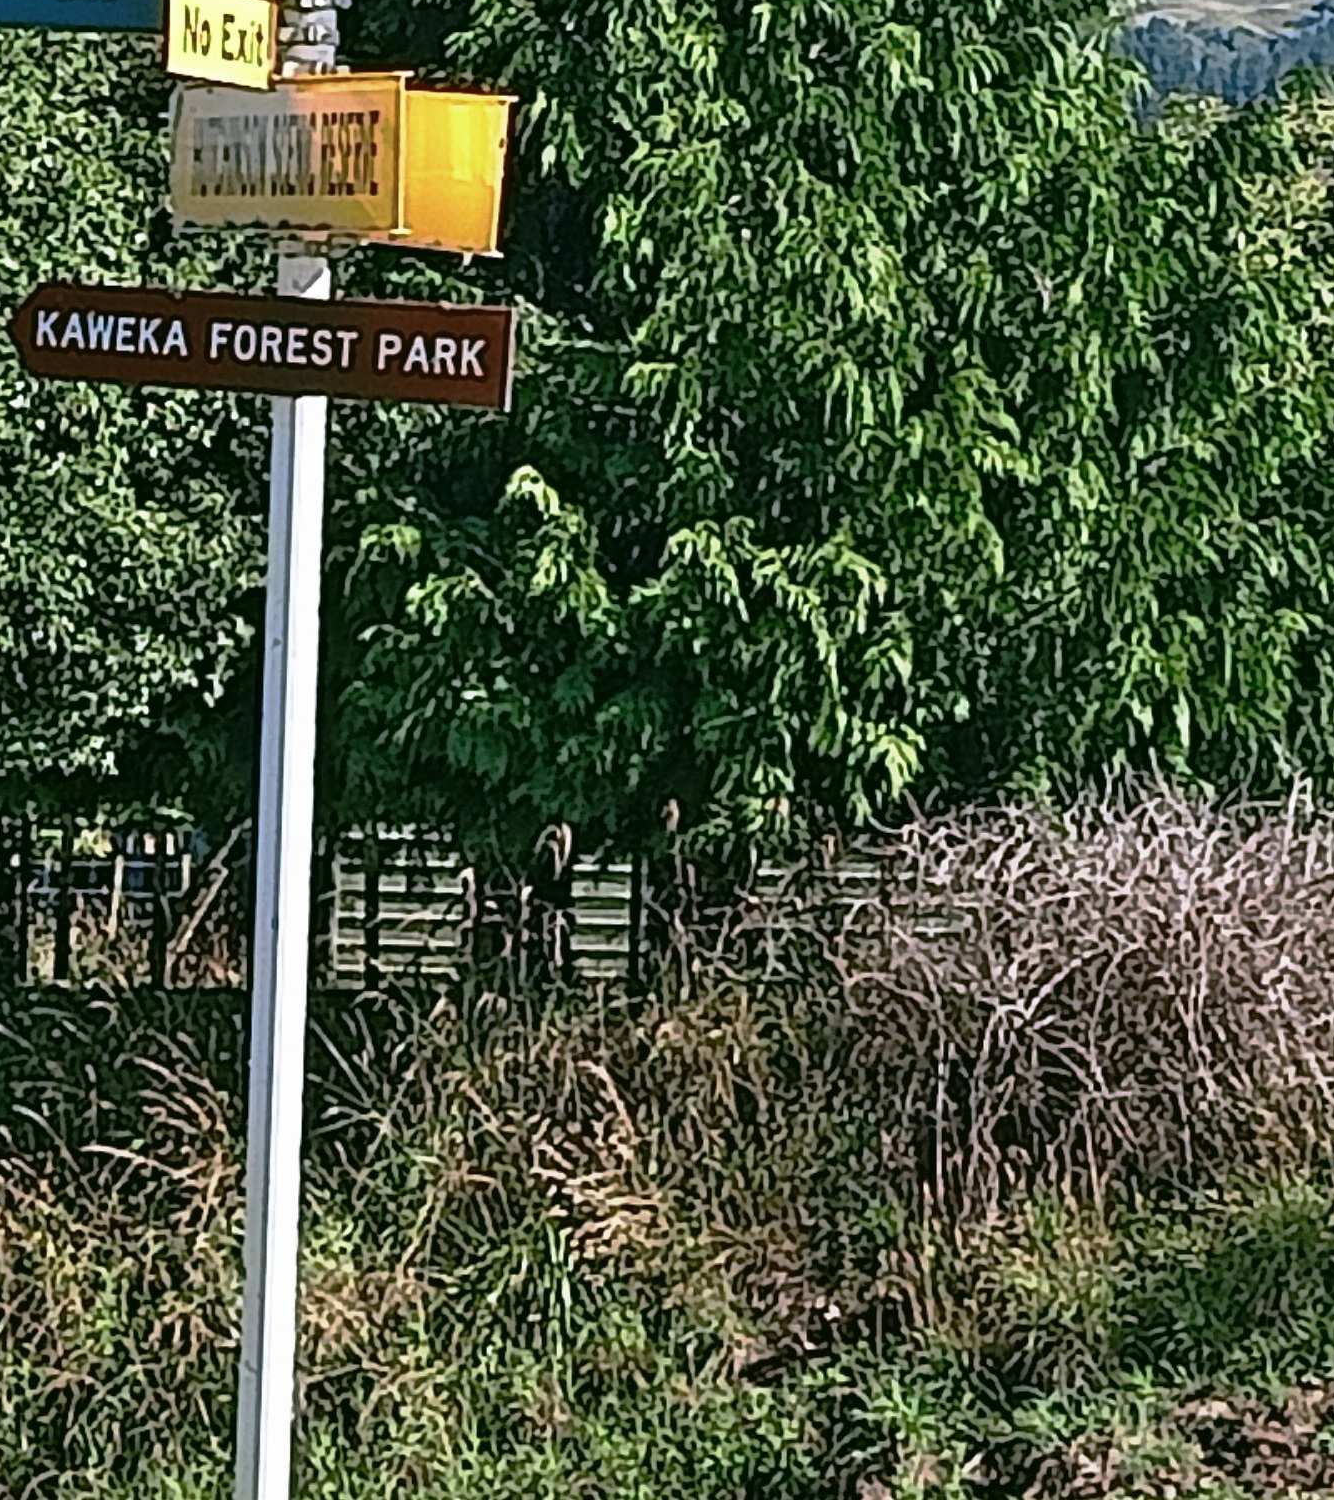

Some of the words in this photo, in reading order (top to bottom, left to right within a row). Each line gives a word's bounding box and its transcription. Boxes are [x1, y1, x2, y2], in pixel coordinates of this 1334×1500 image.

[182, 4, 212, 57] No
[221, 13, 264, 68] Exit
[35, 310, 188, 357] KAWEKA
[210, 322, 359, 368] FOREST
[377, 334, 486, 377] PARK
